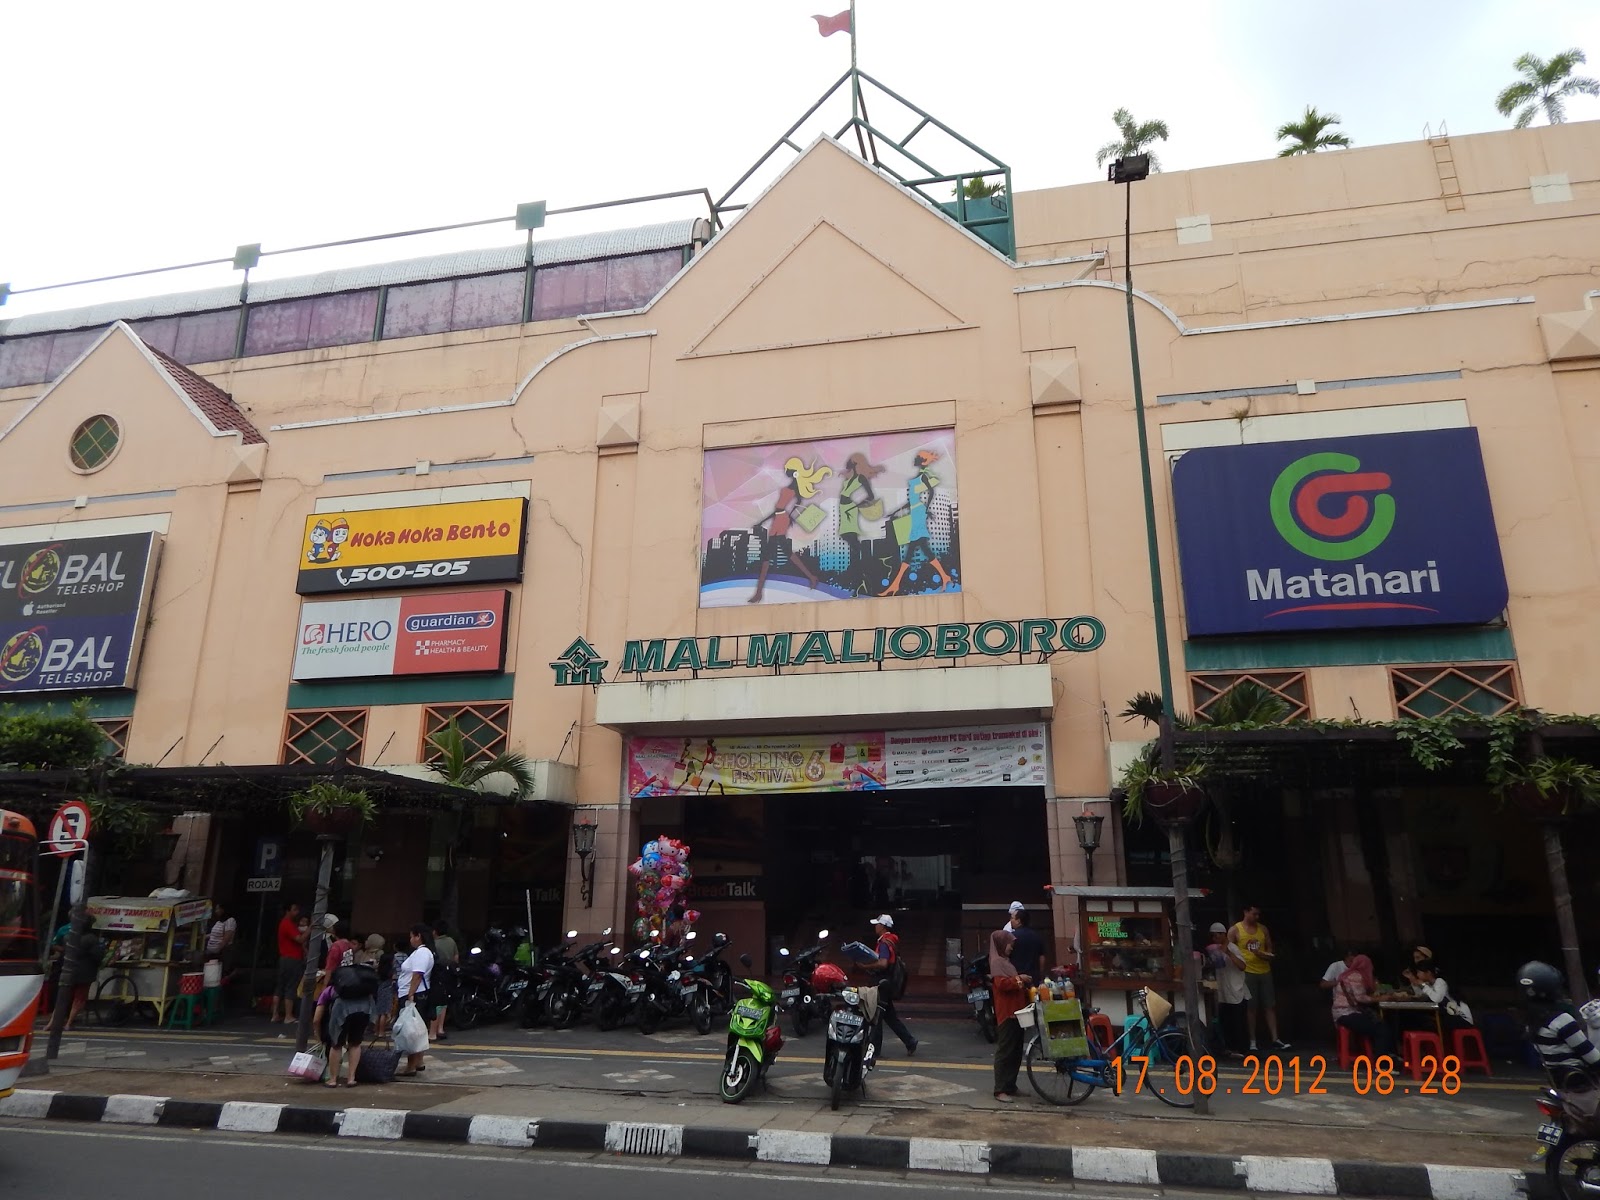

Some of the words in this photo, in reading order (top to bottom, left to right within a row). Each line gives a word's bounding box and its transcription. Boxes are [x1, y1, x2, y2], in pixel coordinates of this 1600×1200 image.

[446, 520, 511, 541] Bento
[350, 561, 470, 582] 500-505
[1246, 560, 1440, 601] Matahari
[56, 581, 124, 596] TELESHOP
[326, 620, 392, 643] HERO
[411, 615, 474, 630] guardian
[301, 646, 317, 655] The
[316, 645, 339, 656] fresh
[338, 643, 360, 654] food
[360, 642, 390, 653] people
[431, 638, 466, 647] PHARMACY
[462, 645, 489, 653] BEAUTY
[621, 637, 735, 674] MAL
[746, 614, 1107, 668] MALIOBORO
[38, 670, 113, 685] TELESHOP
[712, 751, 804, 770] SHOPPING
[732, 767, 804, 783] FESTIVAL
[805, 750, 825, 782] 6
[260, 843, 277, 870] P
[248, 880, 273, 889] RODA
[274, 880, 280, 889] 2
